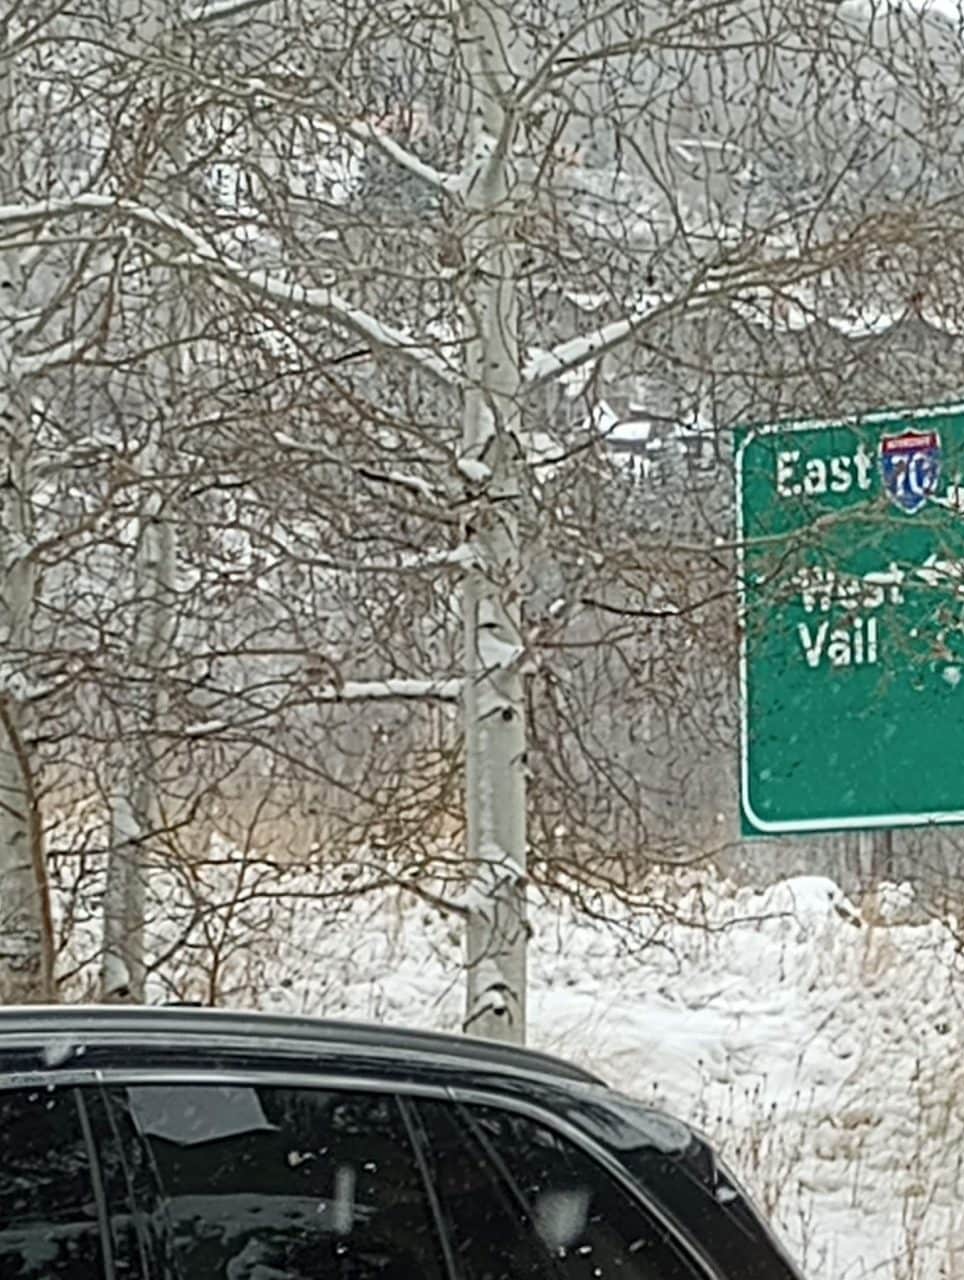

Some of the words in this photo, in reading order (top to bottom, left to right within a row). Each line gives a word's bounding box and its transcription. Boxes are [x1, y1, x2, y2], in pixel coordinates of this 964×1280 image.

[777, 444, 872, 497] East
[891, 452, 931, 497] 70
[799, 617, 877, 667] Vail
